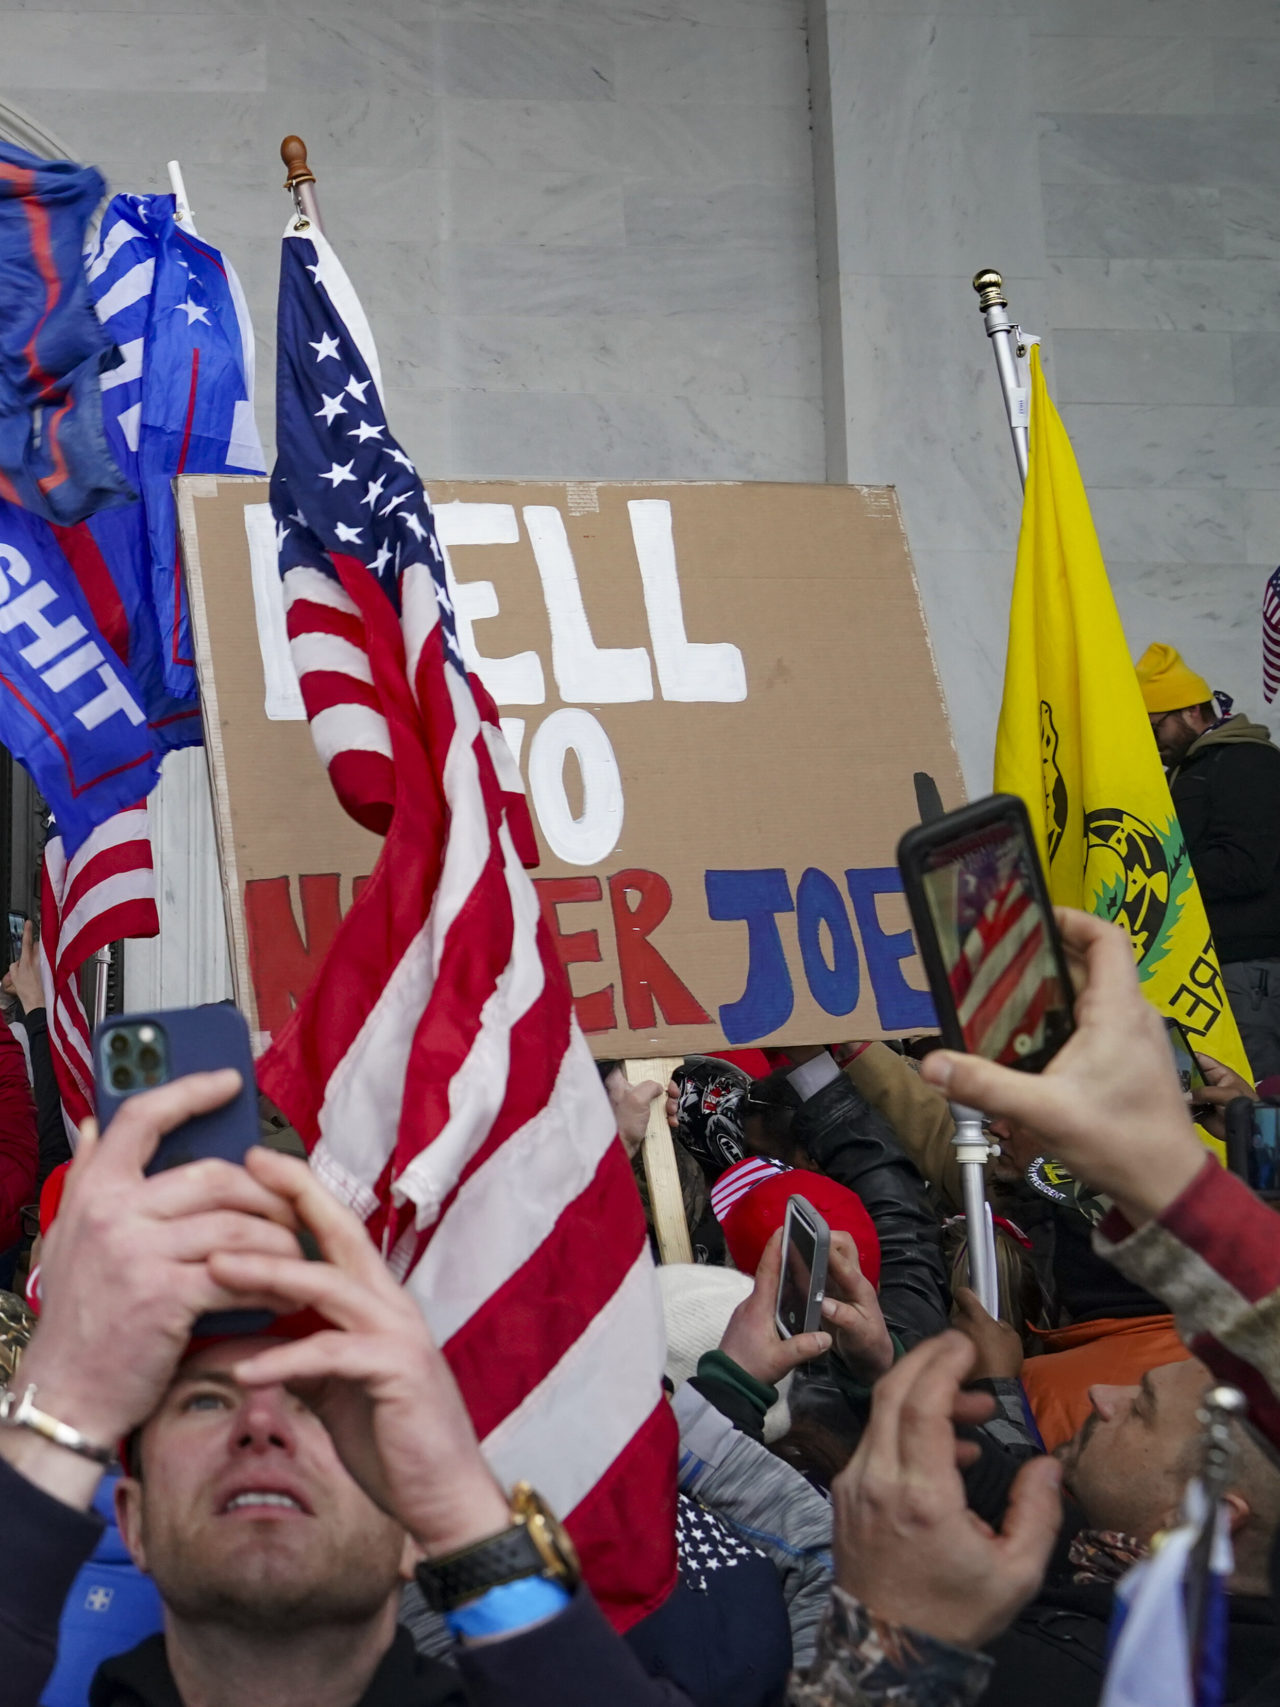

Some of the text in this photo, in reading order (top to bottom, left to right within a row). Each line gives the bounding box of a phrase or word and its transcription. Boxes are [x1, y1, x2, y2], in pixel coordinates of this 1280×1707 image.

[504, 708, 624, 866] O
[245, 868, 939, 1044] NER JOE
[1028, 1172, 1068, 1200] PRESIDENT
